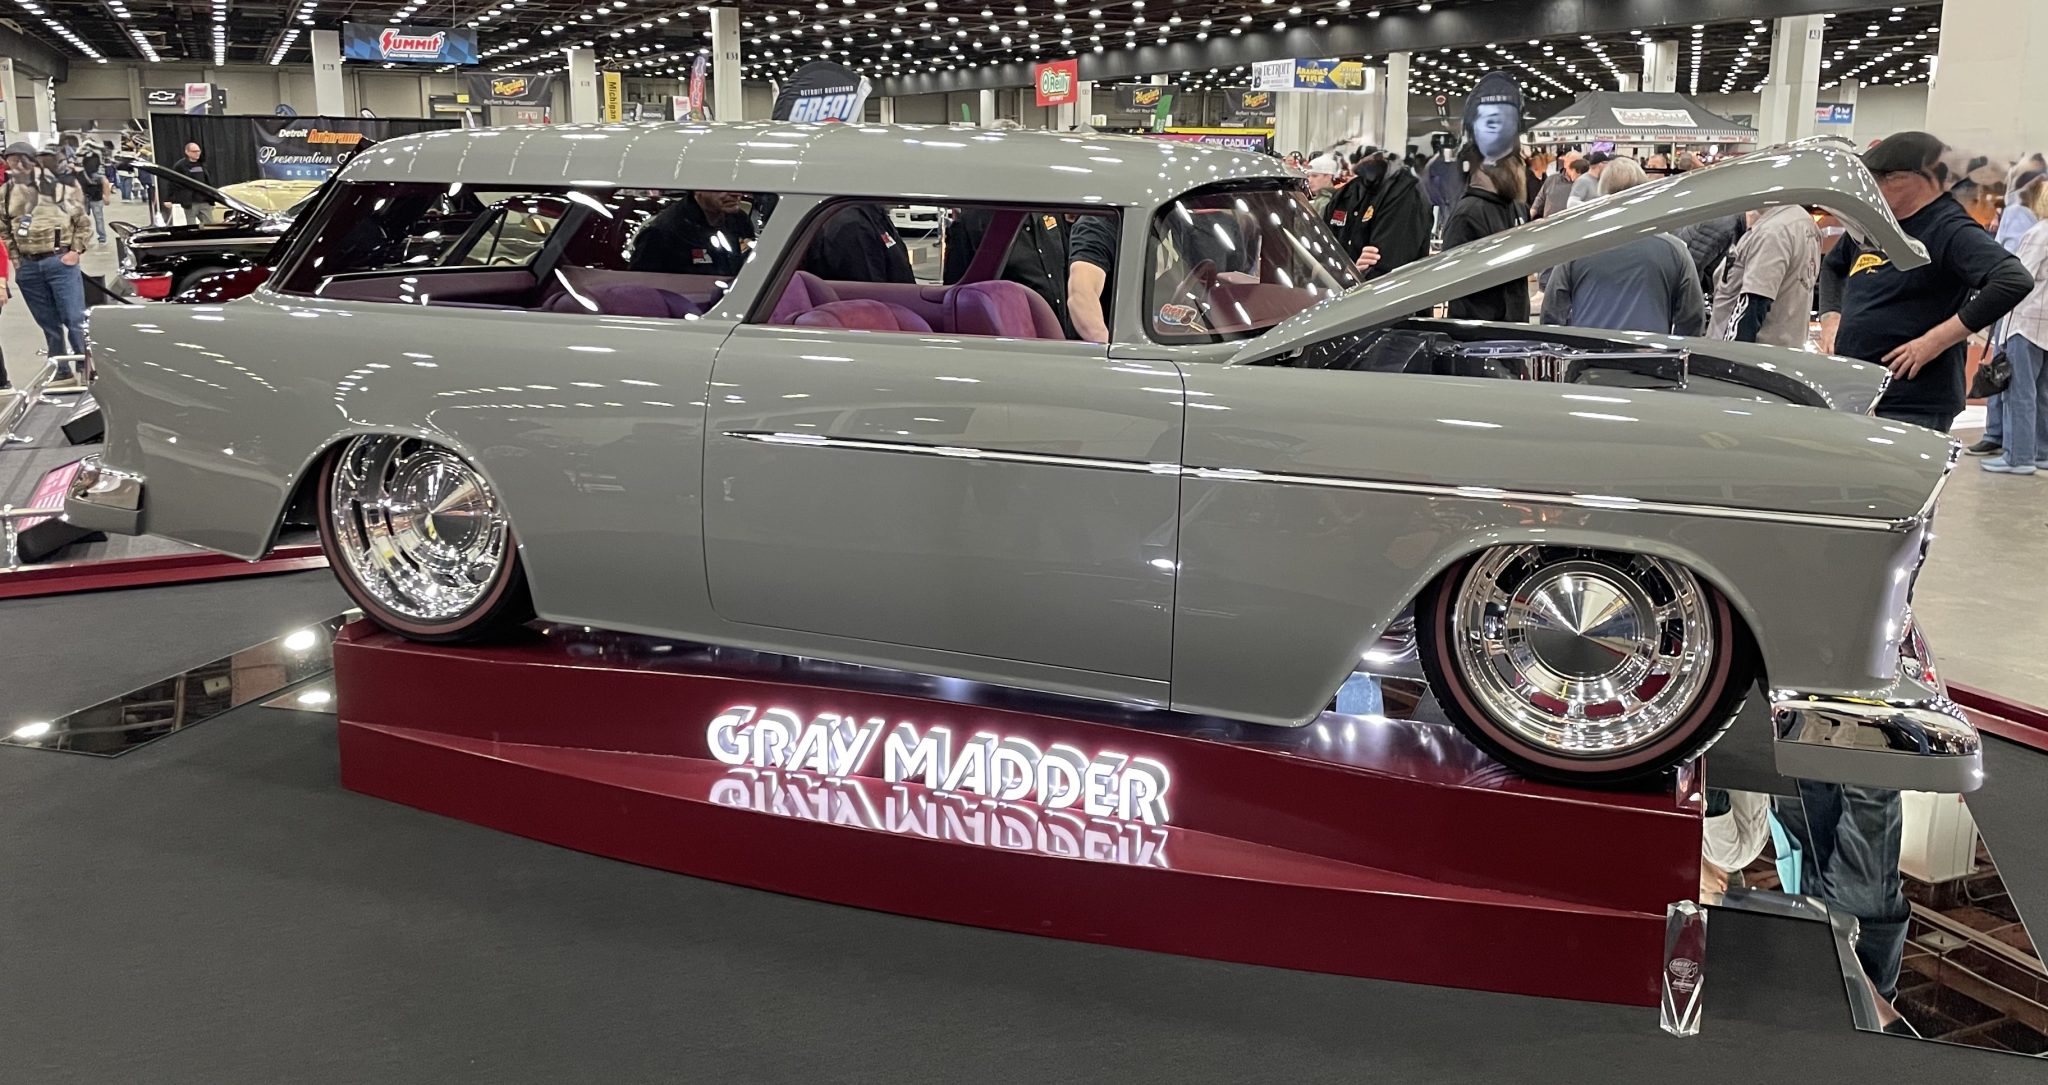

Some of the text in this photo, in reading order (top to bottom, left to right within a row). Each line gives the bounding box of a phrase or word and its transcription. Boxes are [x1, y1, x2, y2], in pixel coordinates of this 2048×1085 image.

[1299, 74, 1326, 84] TIRE
[800, 85, 854, 96] DETROIT AUTORAMA
[608, 81, 617, 120] Michigan
[789, 94, 857, 122] GREAT
[279, 129, 308, 138] Detroit
[1224, 138, 1262, 147] CADILLAC
[260, 146, 332, 164] Preservation
[707, 706, 1170, 827] GRAY MADDER
